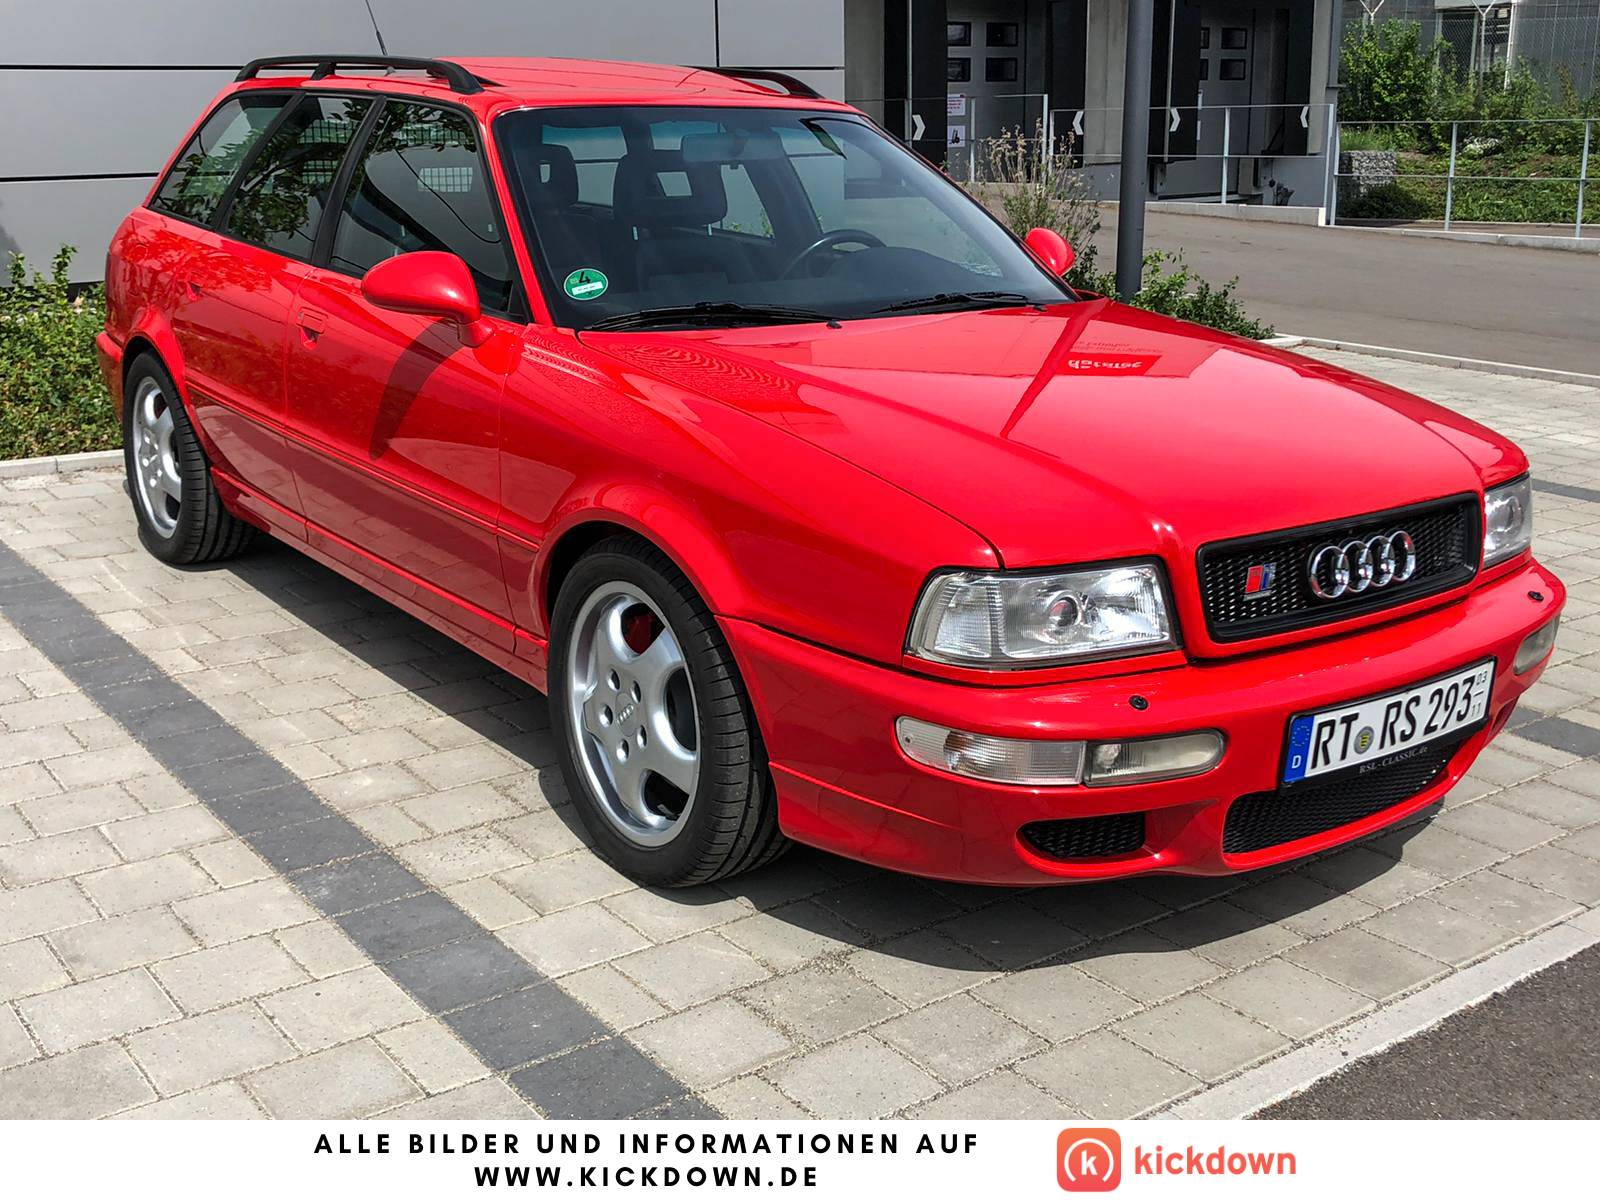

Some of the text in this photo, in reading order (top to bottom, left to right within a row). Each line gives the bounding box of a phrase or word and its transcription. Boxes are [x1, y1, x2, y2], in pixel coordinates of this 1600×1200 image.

[579, 271, 591, 284] 4
[1476, 671, 1488, 685] 03
[1311, 675, 1476, 769] RT RS 293
[1291, 755, 1302, 769] D
